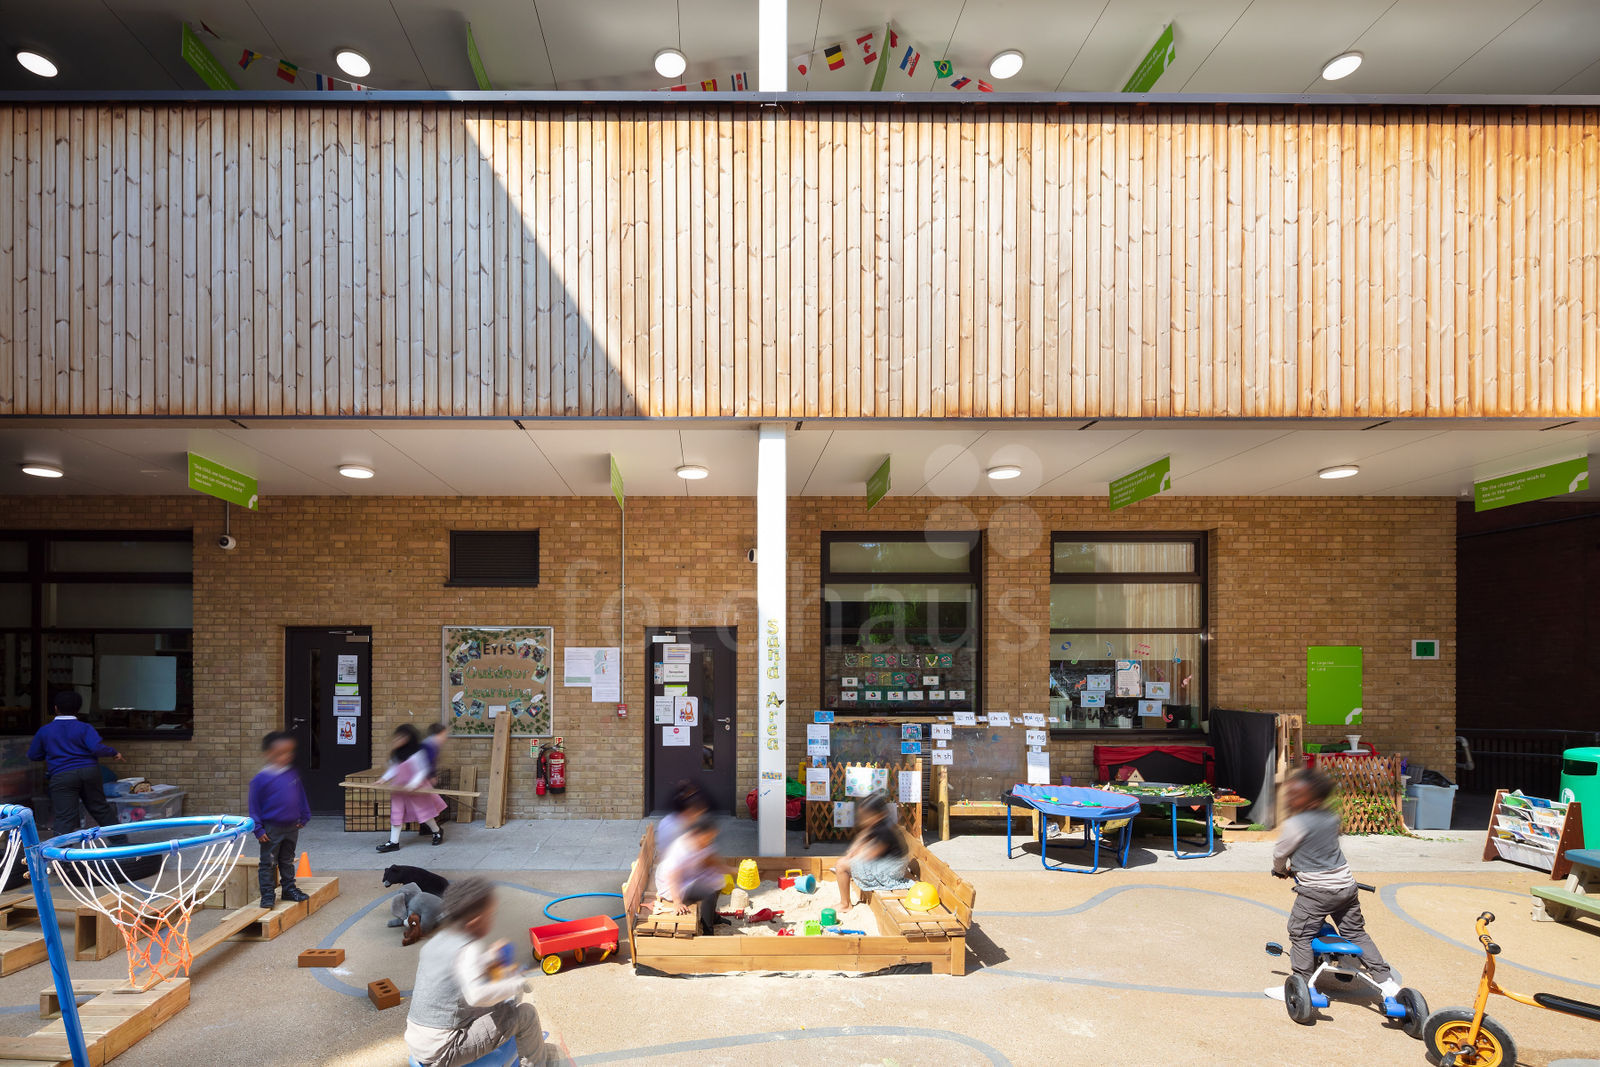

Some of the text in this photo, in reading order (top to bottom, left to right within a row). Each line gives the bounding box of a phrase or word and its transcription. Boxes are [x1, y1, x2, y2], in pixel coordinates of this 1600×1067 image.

[483, 643, 516, 656] EYFS
[465, 664, 530, 680] Outdoor
[464, 684, 533, 701] Learning
